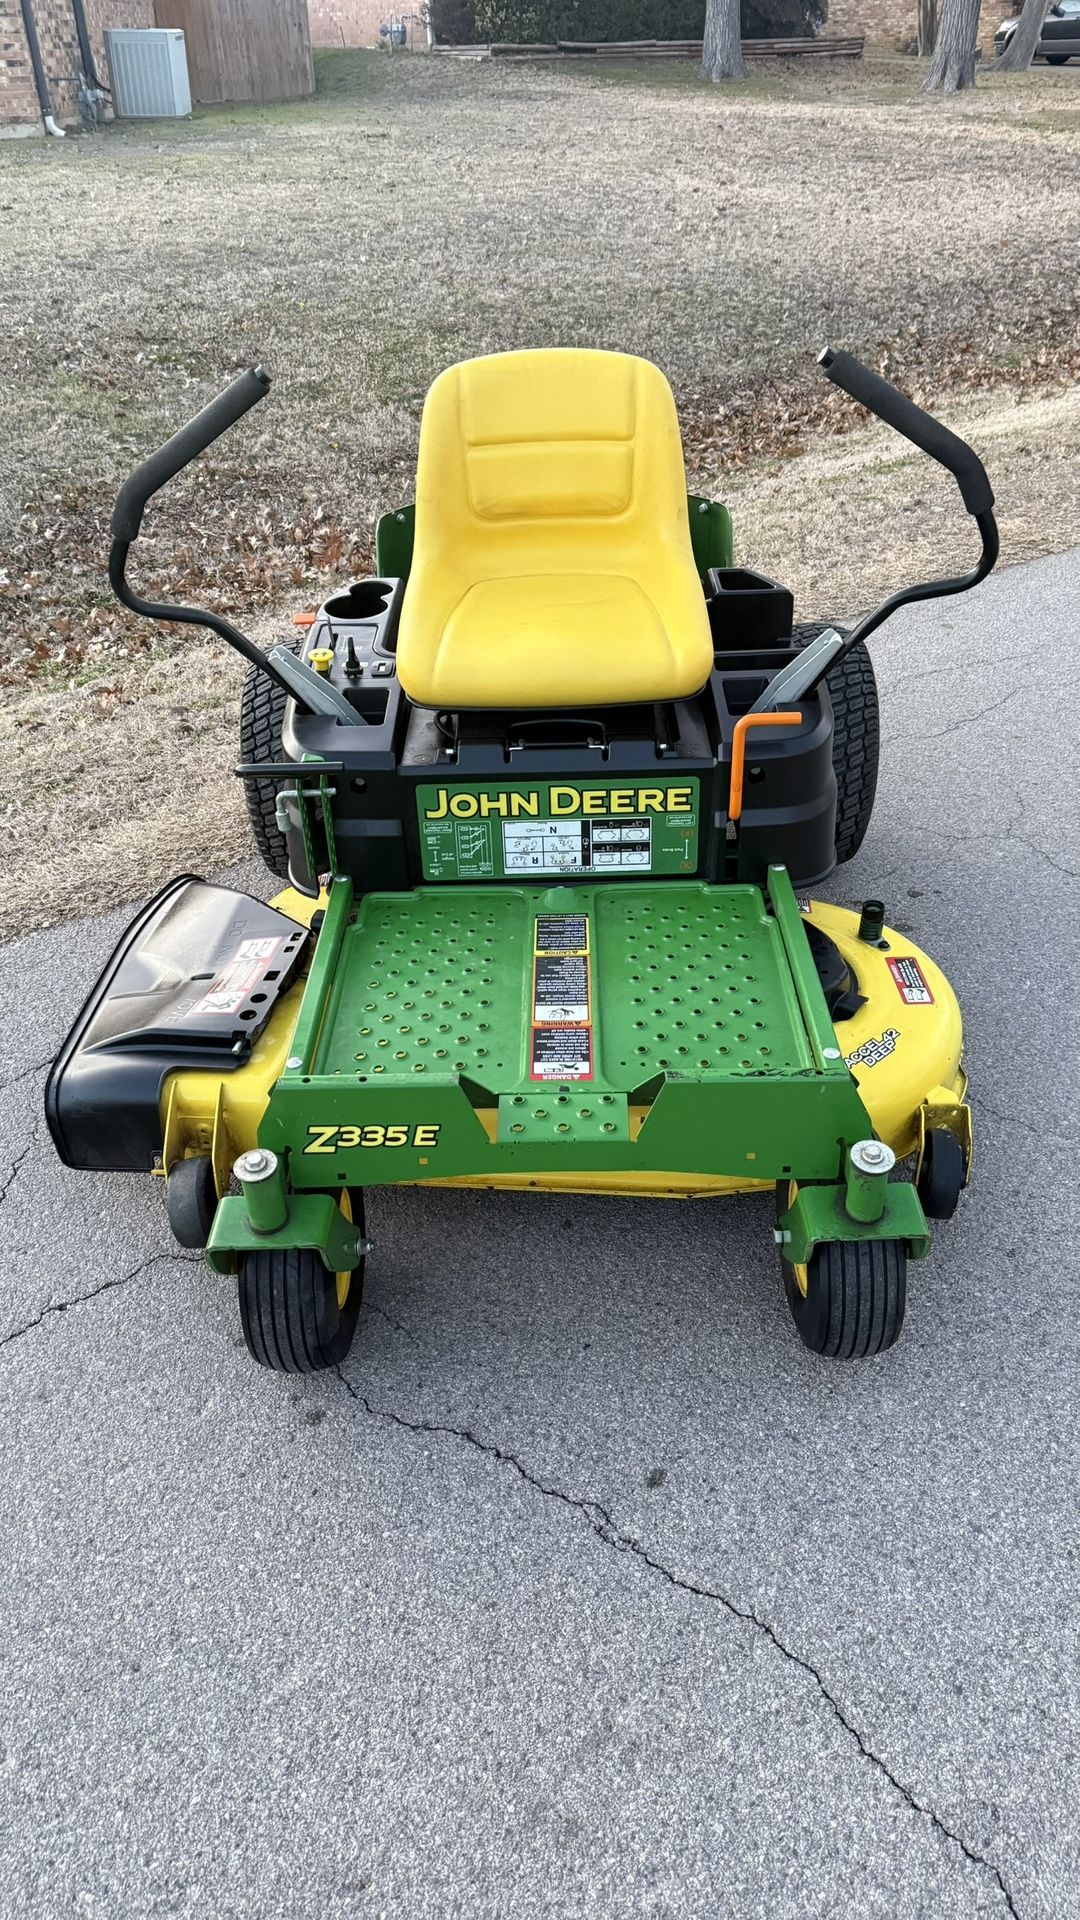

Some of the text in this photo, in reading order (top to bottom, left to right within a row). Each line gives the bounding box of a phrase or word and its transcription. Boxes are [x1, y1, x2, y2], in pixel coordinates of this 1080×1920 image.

[425, 785, 693, 819] JOHN DEERE
[549, 826, 557, 834] N
[531, 856, 539, 864] R
[843, 1028, 900, 1069] ACCEL 42
[862, 1040, 896, 1067] DEEP
[302, 1124, 442, 1154] Z335 E
